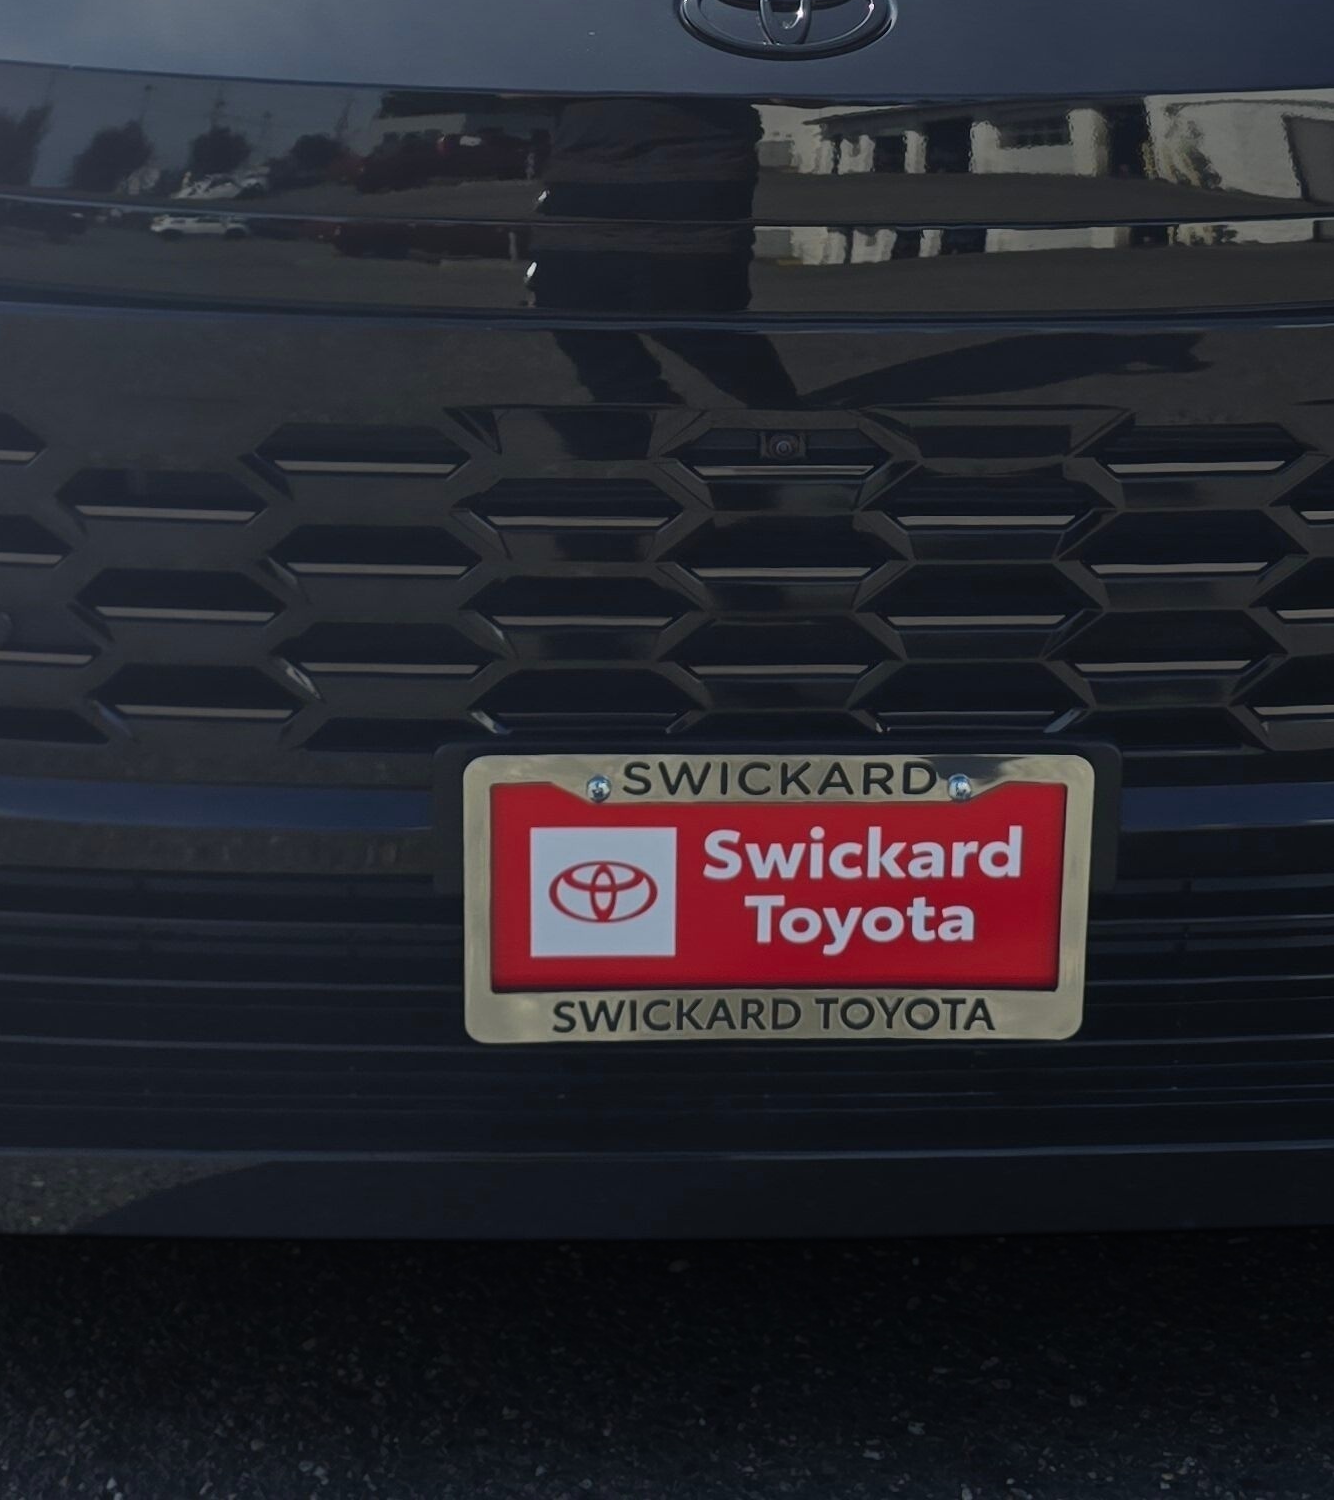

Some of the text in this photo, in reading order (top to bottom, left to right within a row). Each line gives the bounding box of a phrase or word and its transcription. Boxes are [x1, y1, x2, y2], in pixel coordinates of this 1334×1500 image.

[622, 761, 938, 797] SWICKARD
[702, 825, 1023, 881] Swickard
[744, 895, 975, 956] Toyota
[551, 996, 996, 1034] SWICKARD TOYOTA
